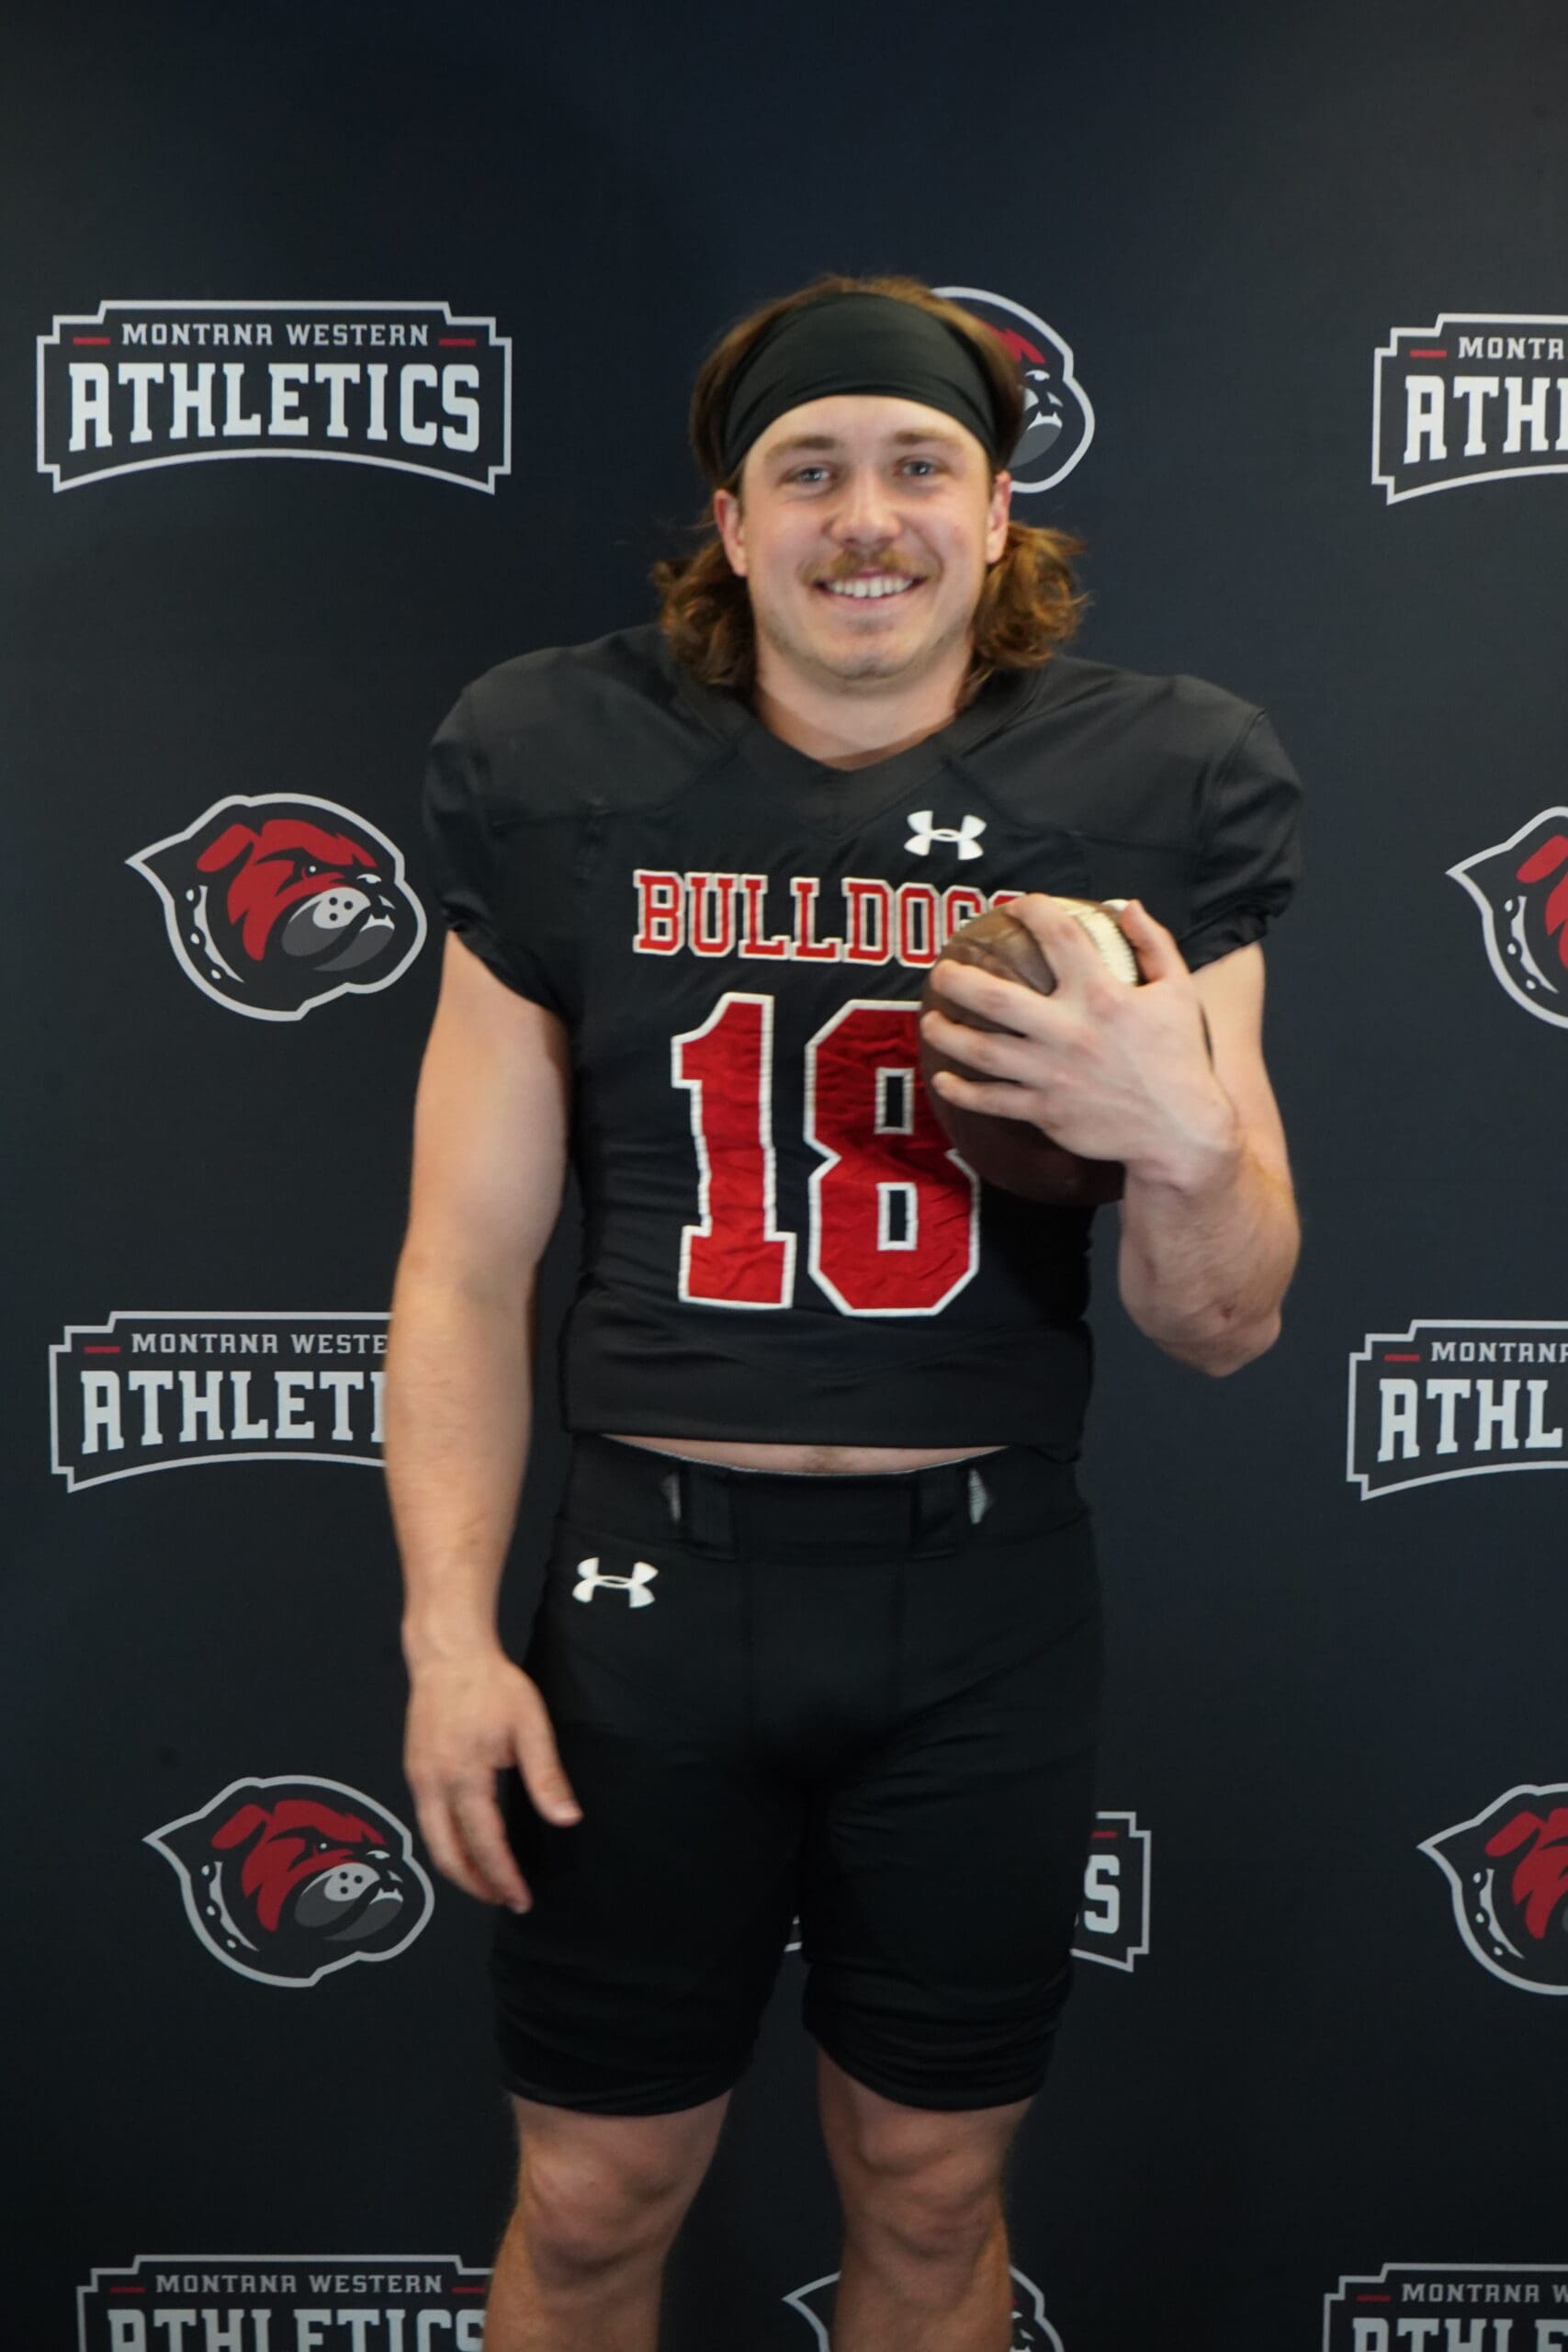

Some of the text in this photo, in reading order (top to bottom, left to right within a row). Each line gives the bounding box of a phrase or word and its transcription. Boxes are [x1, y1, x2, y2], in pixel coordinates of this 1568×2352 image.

[122, 323, 429, 346] MONTANA WESTERN
[69, 363, 479, 452] ATHLETICS
[634, 870, 1026, 969] BULLDOG
[671, 992, 981, 1317] 18
[131, 1333, 278, 1353] MONTANA
[1378, 1378, 1563, 1463] ATHL
[156, 2274, 442, 2293] MONTANA WESTERN
[1402, 2283, 1540, 2303] MONTANA
